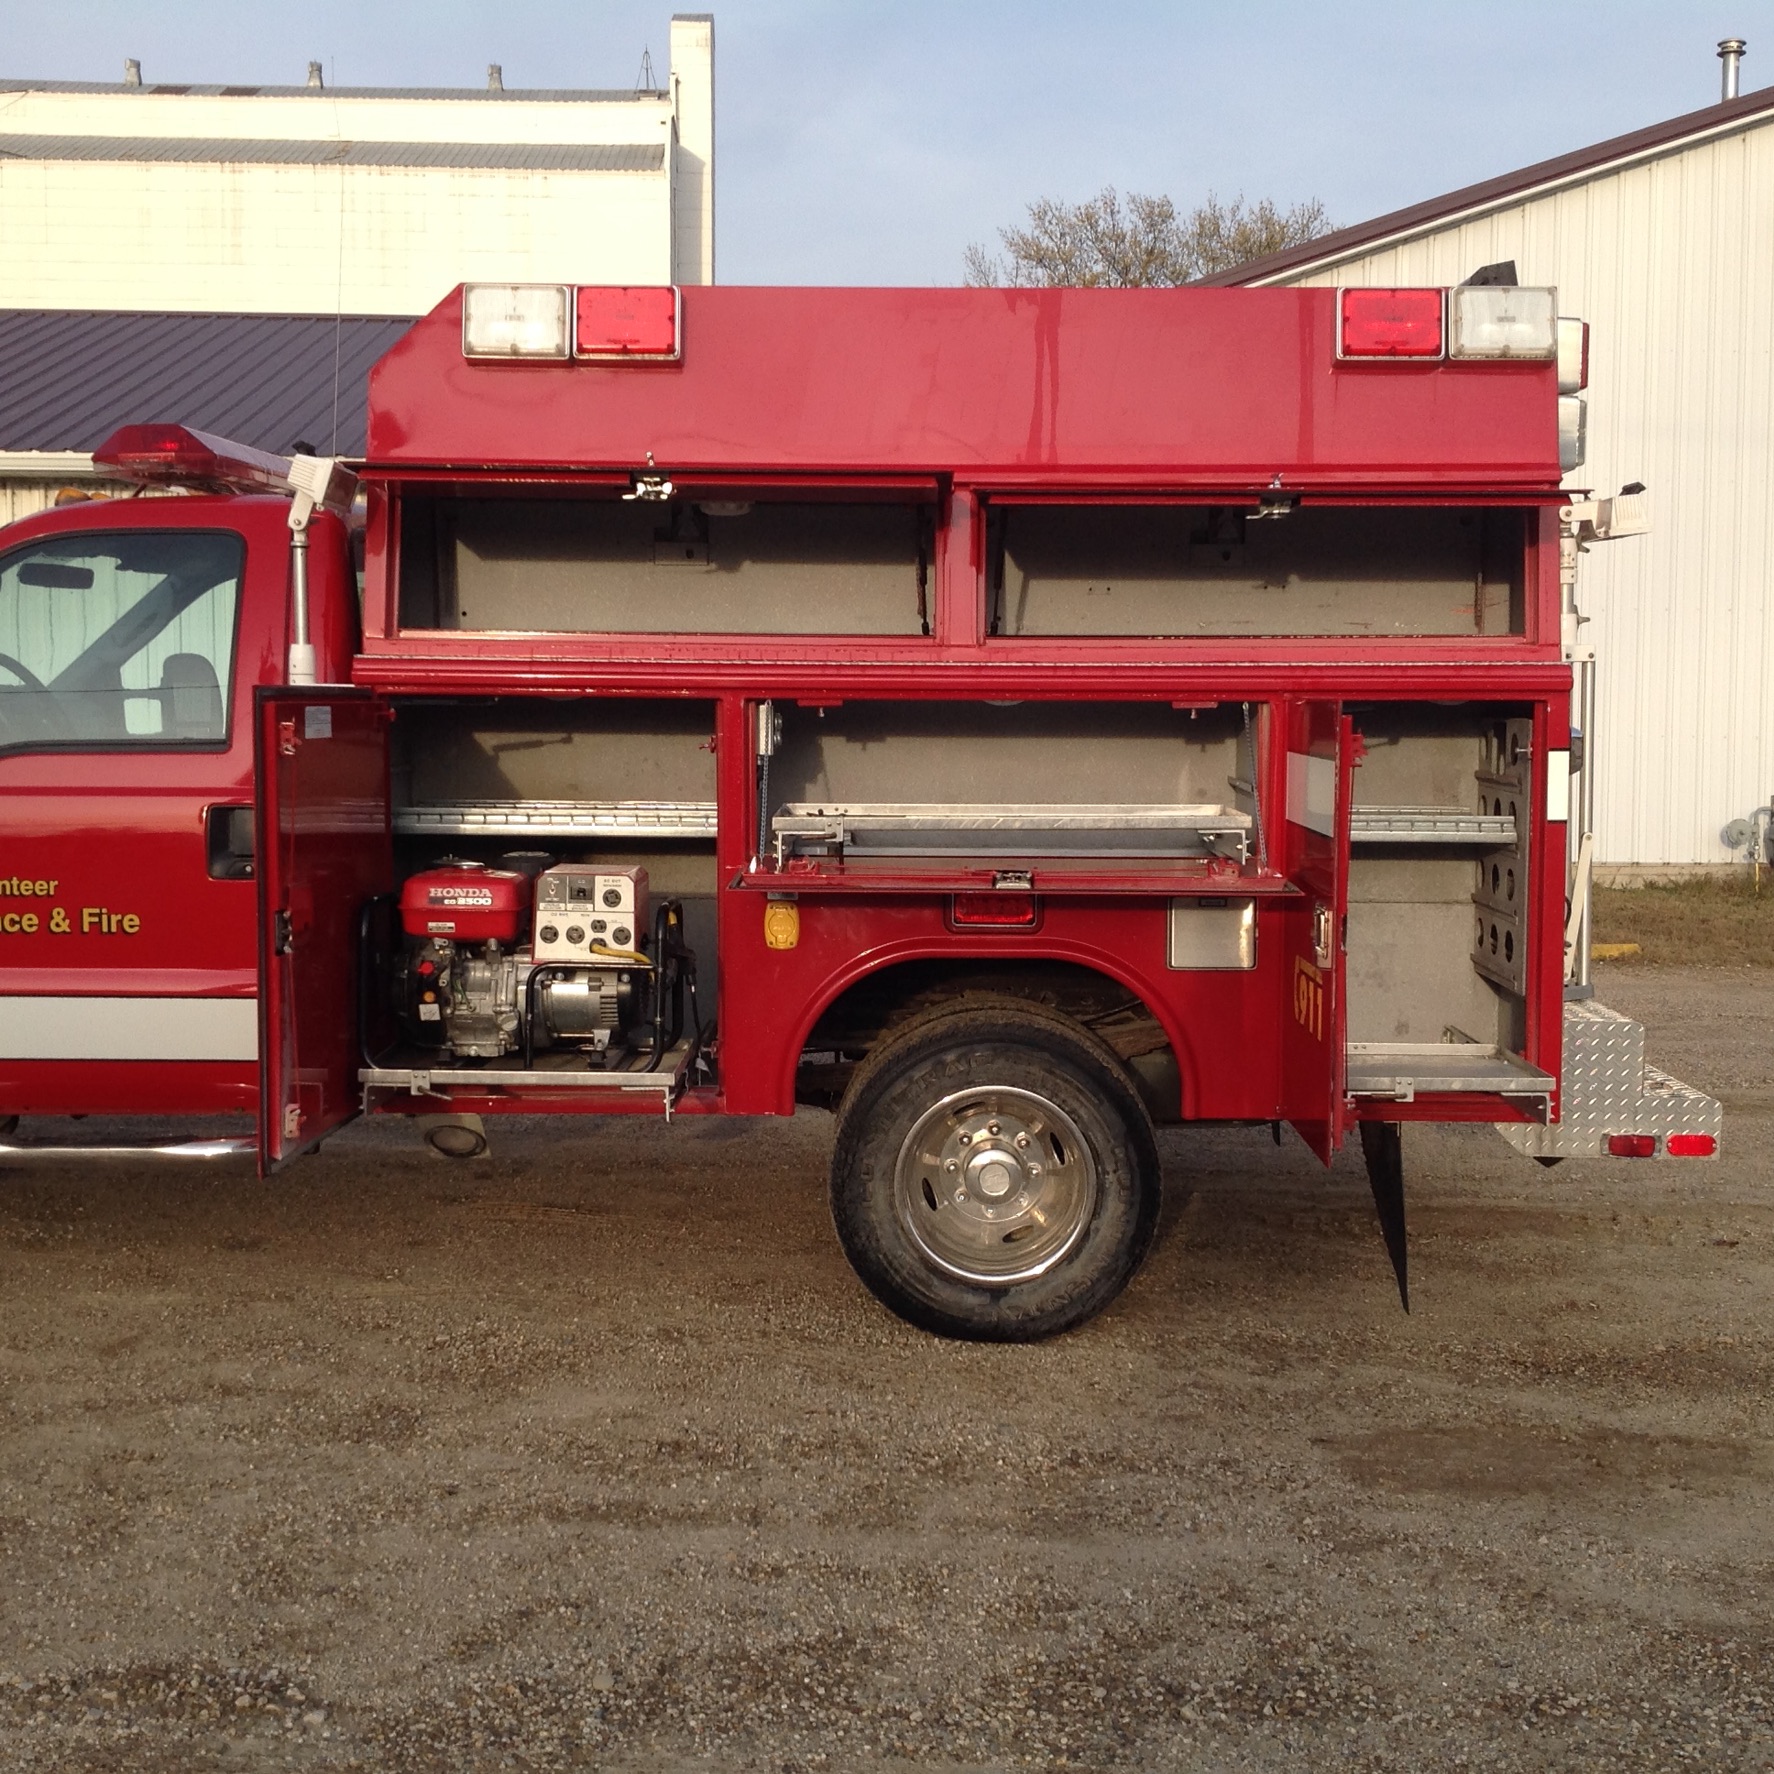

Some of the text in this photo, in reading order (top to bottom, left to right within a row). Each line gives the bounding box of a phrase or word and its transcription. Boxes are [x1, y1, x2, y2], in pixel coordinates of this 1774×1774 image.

[429, 888, 492, 897] HONDA
[0, 907, 141, 933] ce & Fire
[1300, 973, 1323, 1042] 911
